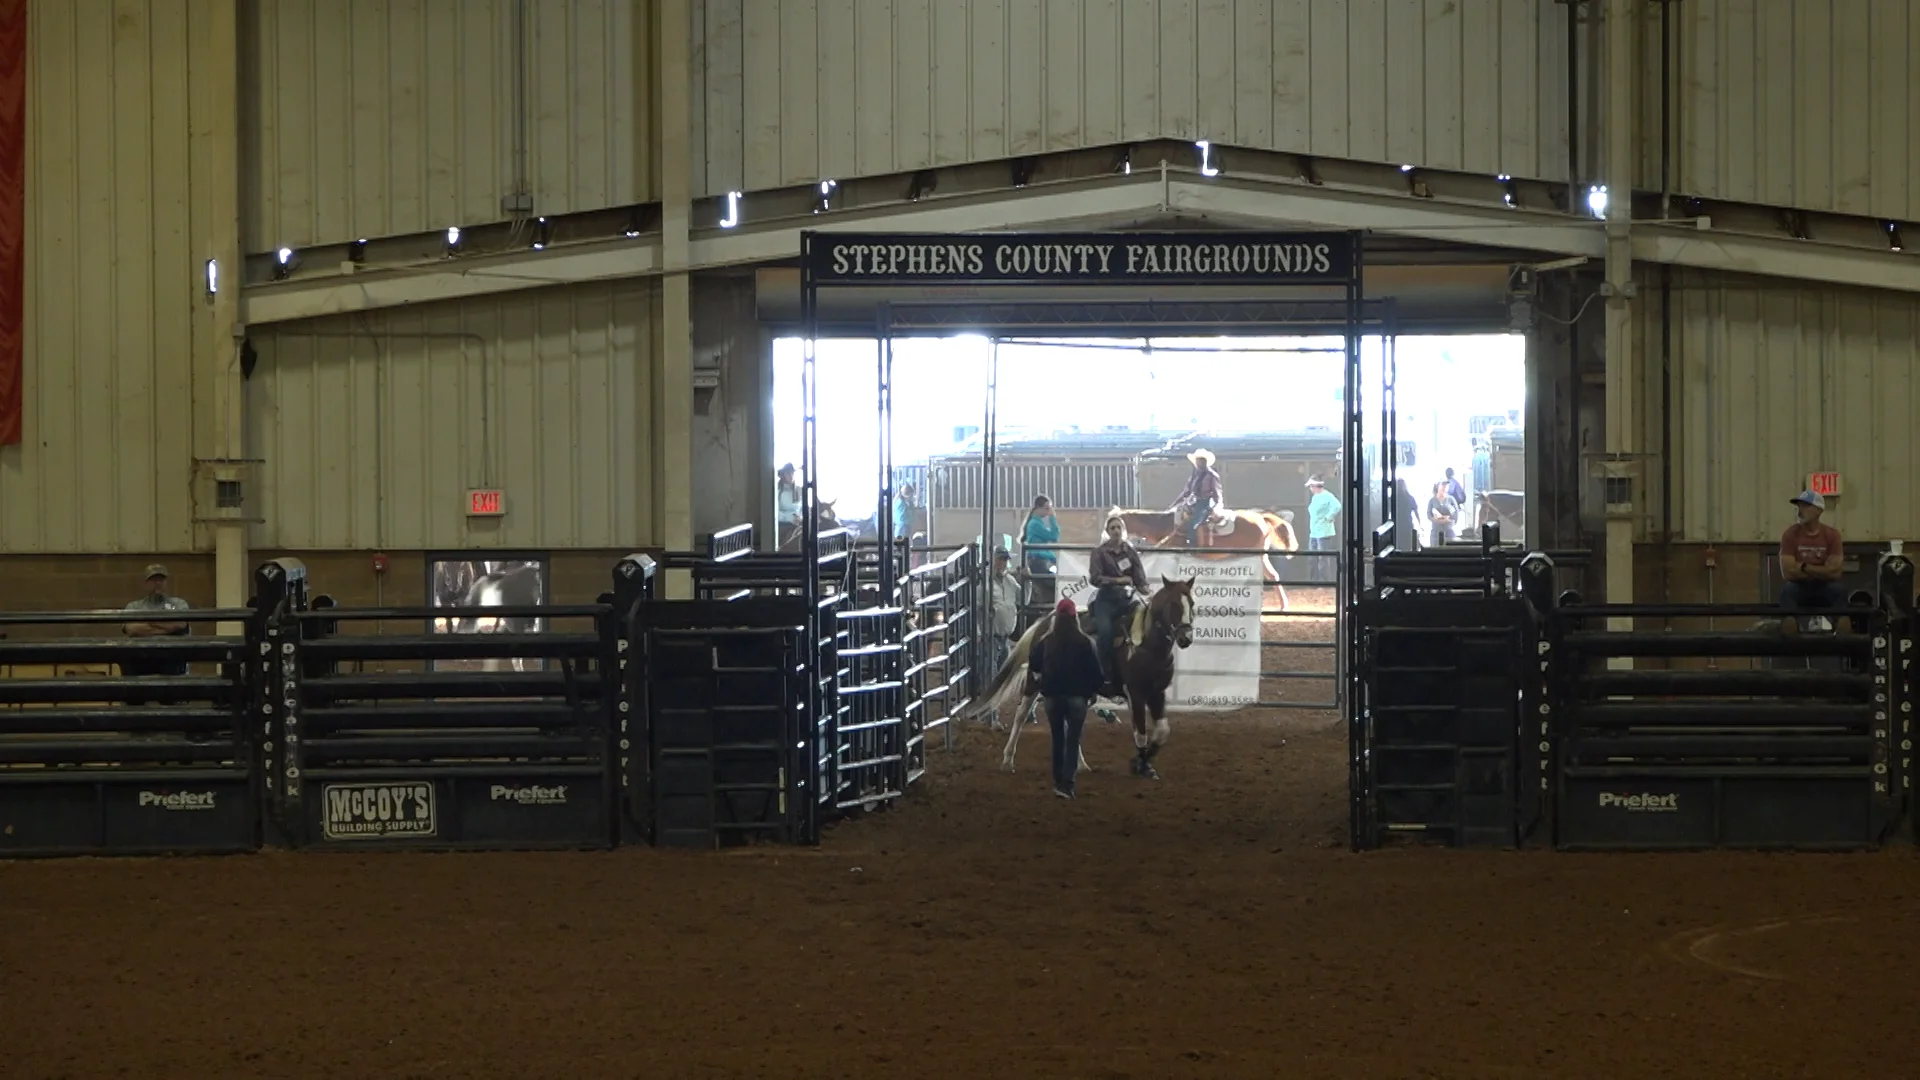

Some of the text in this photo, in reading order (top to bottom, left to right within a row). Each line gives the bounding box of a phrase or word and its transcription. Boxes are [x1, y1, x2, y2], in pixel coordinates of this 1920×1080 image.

[832, 243, 1330, 274] STEPHENS COUNTY FAIRGROUNDS
[1811, 473, 1839, 494] EXIT
[472, 492, 500, 512] EXIT
[1179, 565, 1254, 576] HORSE HOTEL
[1194, 586, 1251, 598] OARDING
[617, 639, 630, 787] Priefert
[1538, 641, 1551, 790] Priefert
[1900, 638, 1913, 788] Priefert
[139, 791, 214, 806] Priefert
[490, 785, 566, 800] Priefert
[1599, 792, 1677, 806] Priefert
[329, 786, 429, 822] McCOY'S
[331, 820, 425, 833] BUILDING SUPPLY
